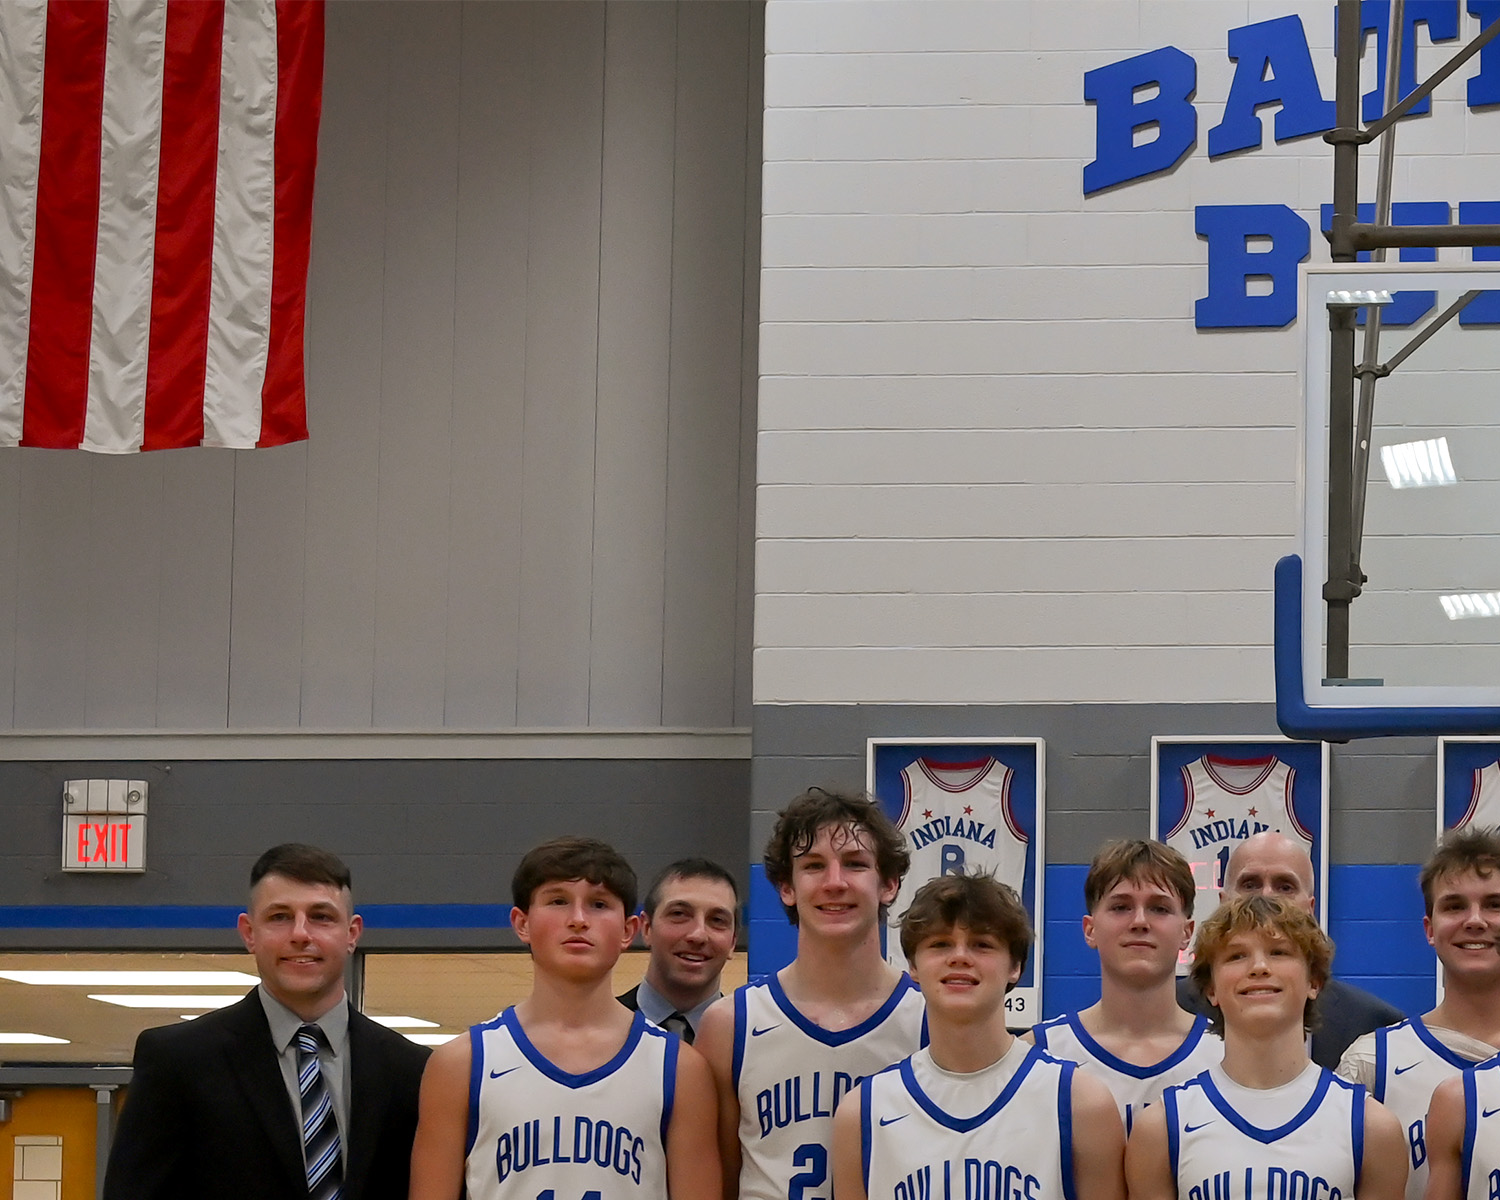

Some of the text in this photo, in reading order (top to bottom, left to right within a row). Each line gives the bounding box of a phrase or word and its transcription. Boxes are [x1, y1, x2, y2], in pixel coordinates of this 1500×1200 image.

[78, 824, 131, 862] EXIT
[910, 816, 996, 850] INDIANA
[497, 1116, 645, 1185] BULLDOGS
